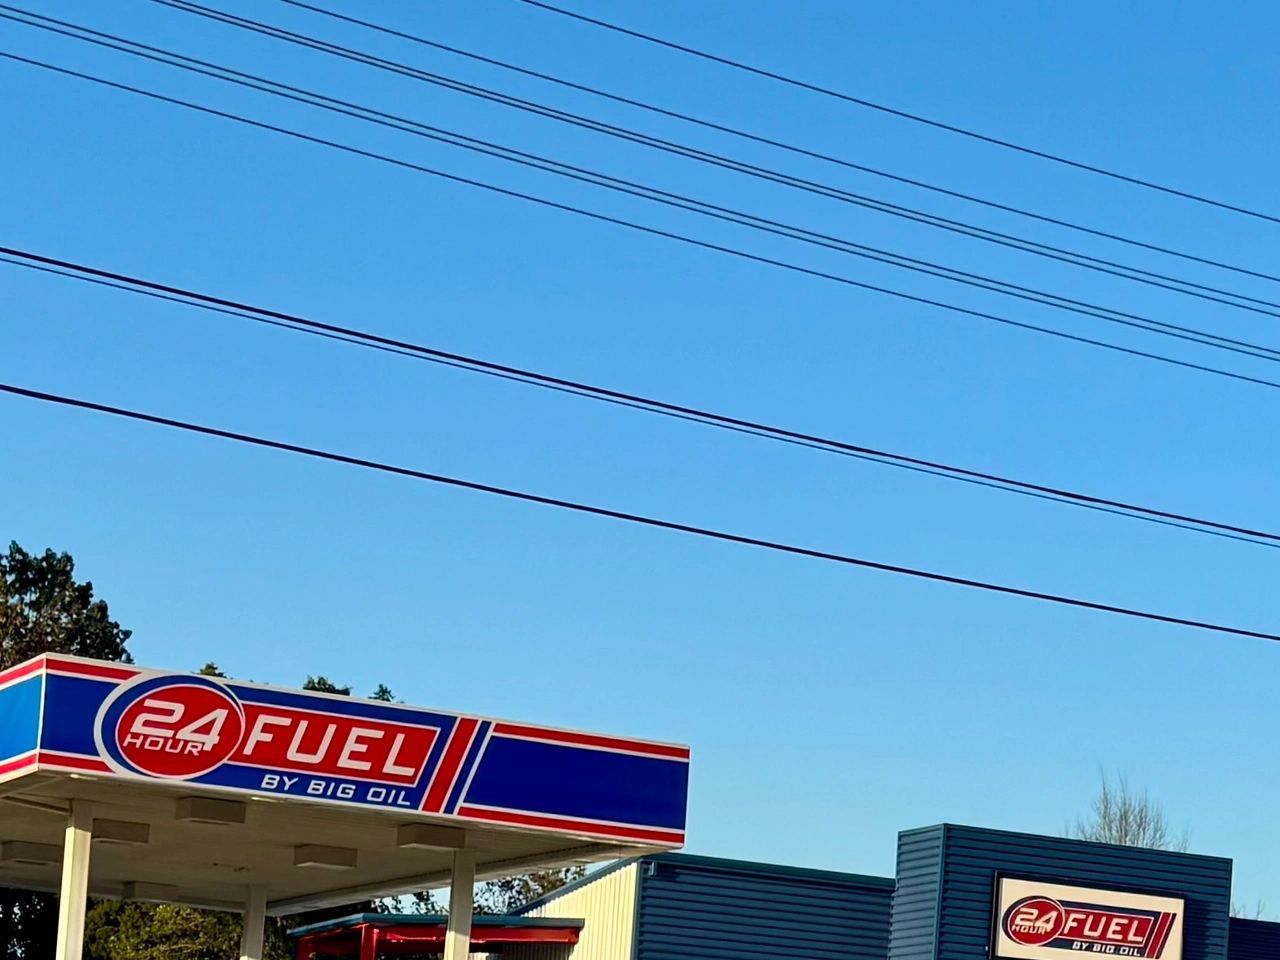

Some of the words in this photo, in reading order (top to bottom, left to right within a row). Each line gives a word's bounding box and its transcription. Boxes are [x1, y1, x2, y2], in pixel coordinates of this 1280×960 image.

[131, 699, 229, 751] 24
[123, 733, 201, 756] HOUR
[243, 713, 416, 776] FUEL
[261, 774, 298, 790] BY
[307, 780, 355, 798] BIG
[367, 788, 411, 806] OIL
[1015, 907, 1058, 932] 24
[1063, 913, 1145, 942] FUEL
[1072, 941, 1088, 951] BY
[1093, 943, 1114, 953] BIG
[1120, 946, 1140, 956] OIL
